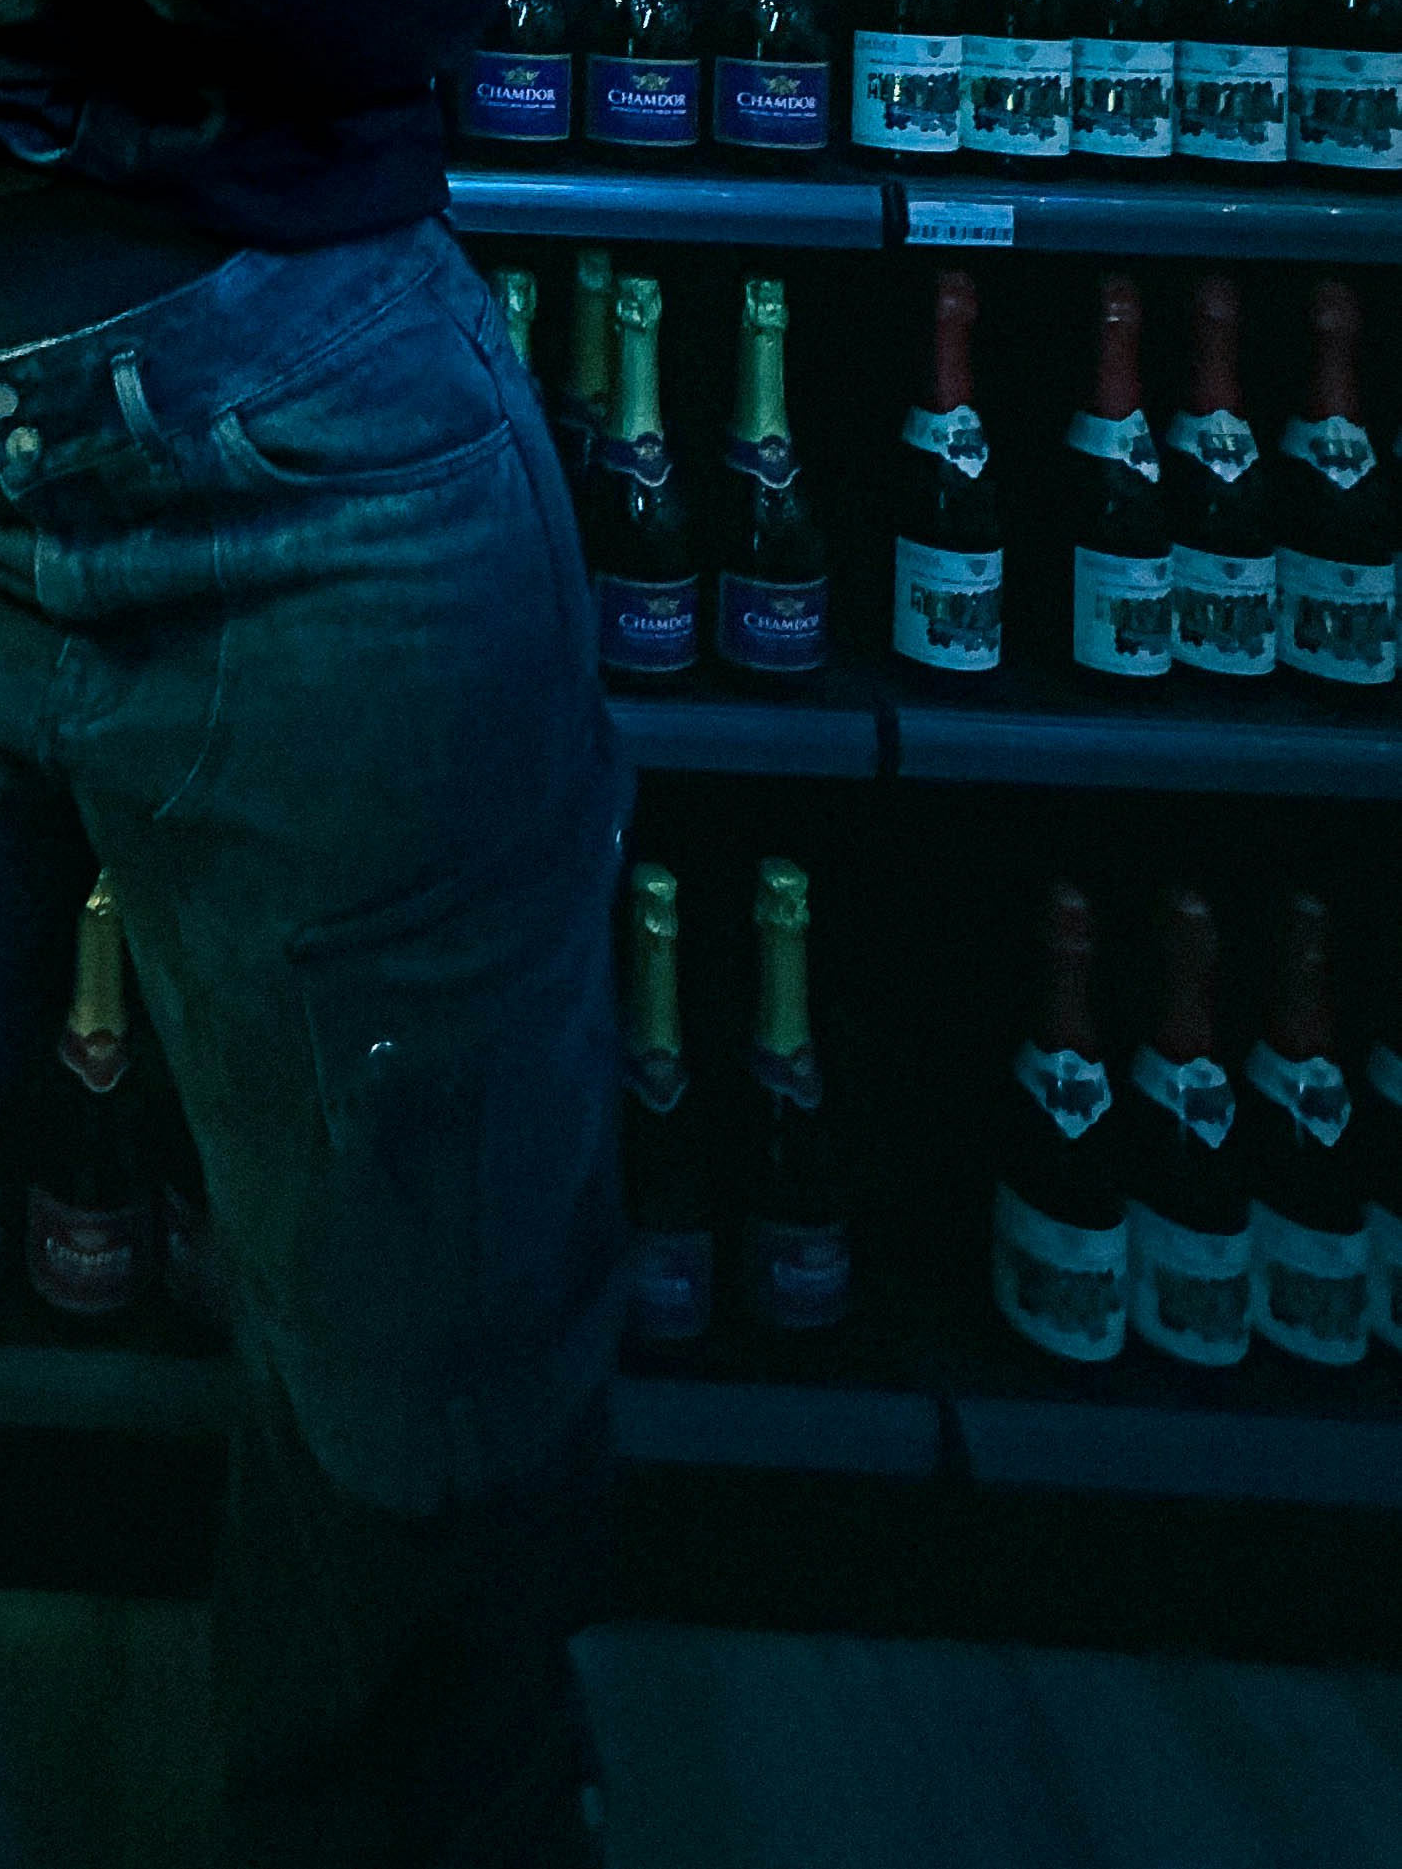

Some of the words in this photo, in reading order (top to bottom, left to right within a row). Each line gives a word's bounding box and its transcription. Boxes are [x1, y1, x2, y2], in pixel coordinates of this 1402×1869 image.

[476, 83, 556, 101] CHAMDOR
[607, 89, 686, 107] CHAMDOR
[736, 92, 818, 109] CHAMDOR
